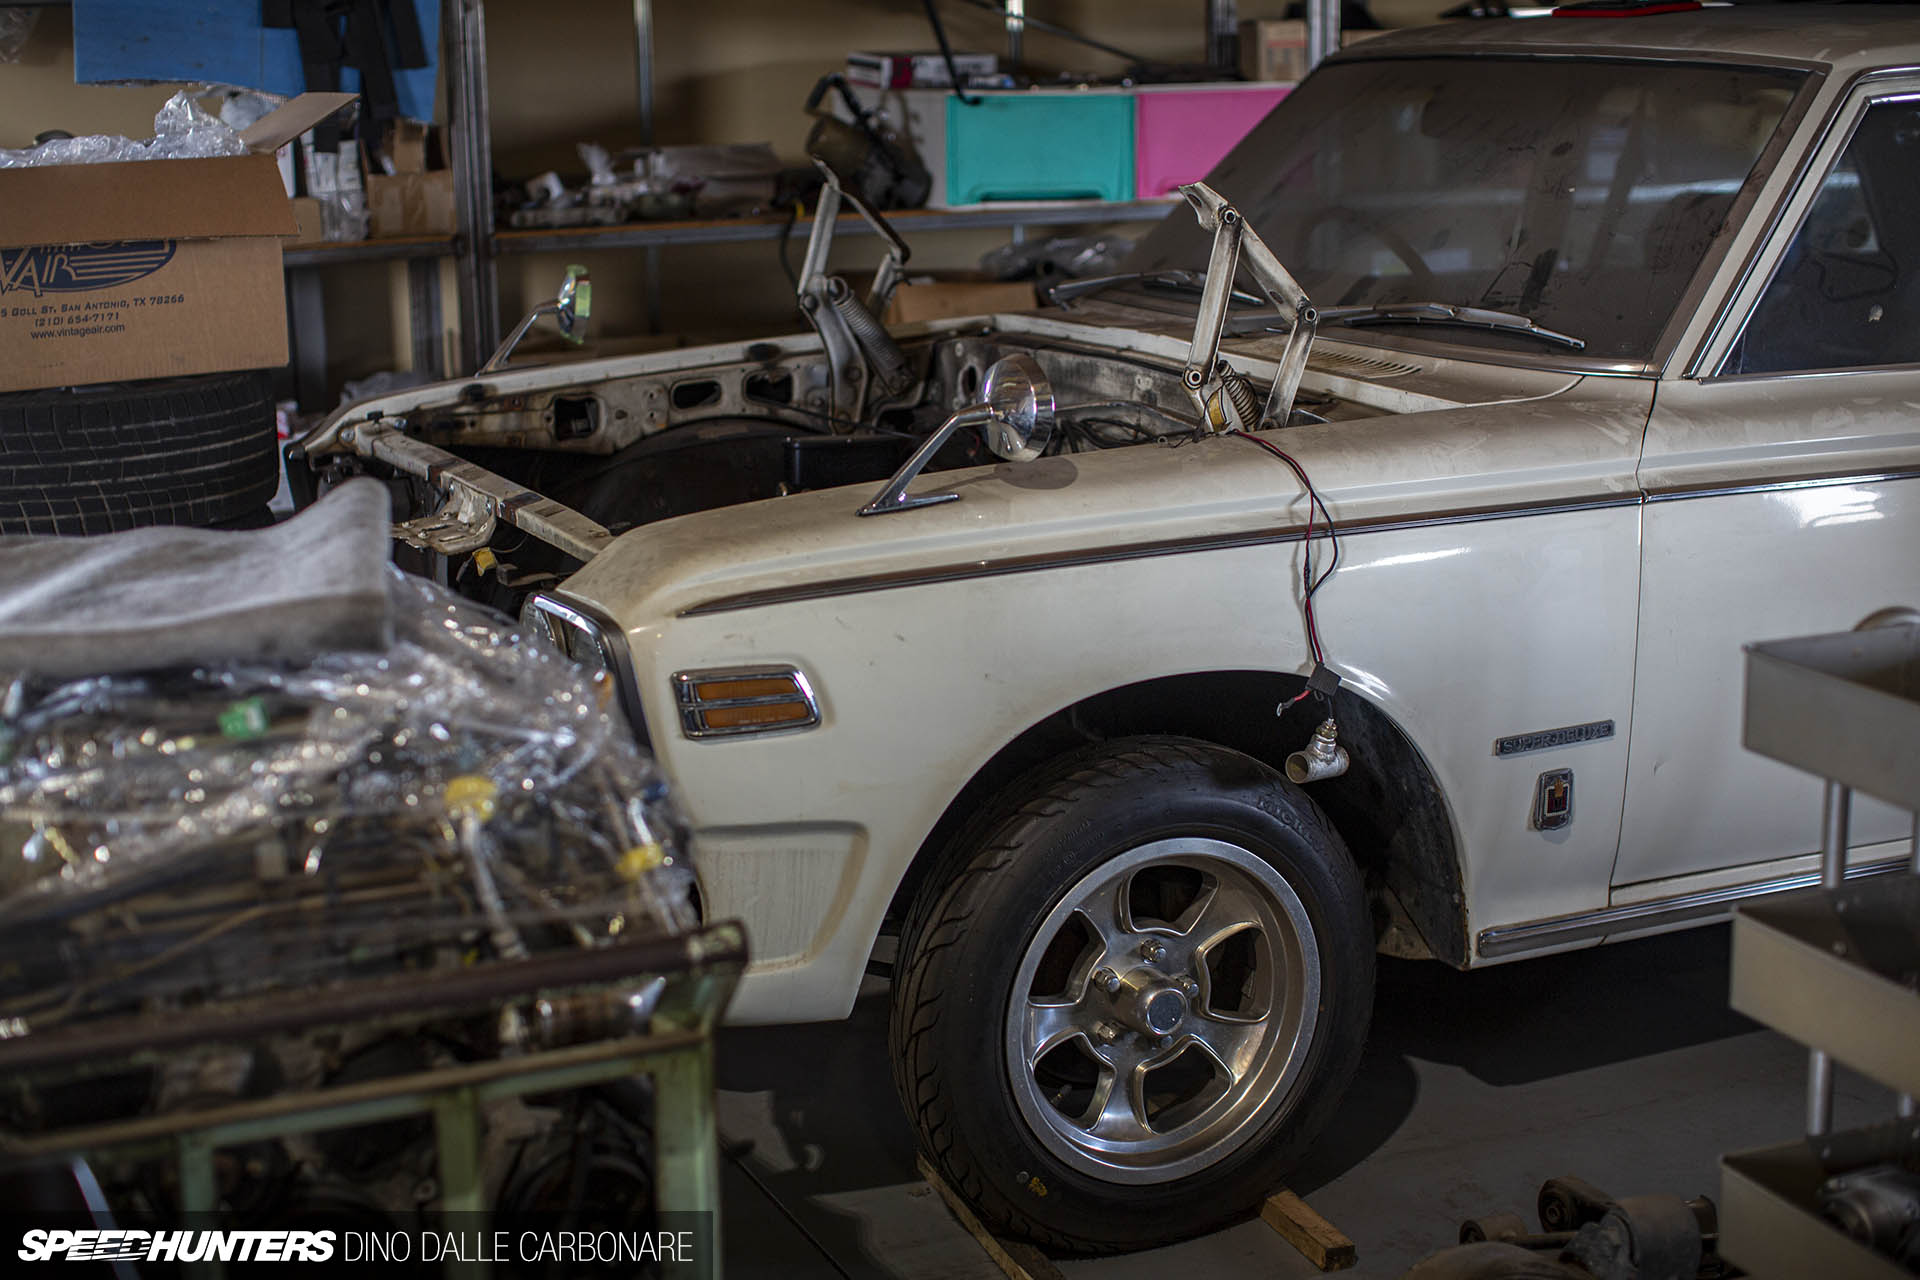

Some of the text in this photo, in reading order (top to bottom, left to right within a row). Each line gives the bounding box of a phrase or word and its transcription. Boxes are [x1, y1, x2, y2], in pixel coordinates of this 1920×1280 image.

[133, 296, 147, 306] TX
[150, 294, 185, 305] 78266
[34, 312, 120, 328] (210) 654-7171
[31, 323, 126, 340] www.vintageair.com
